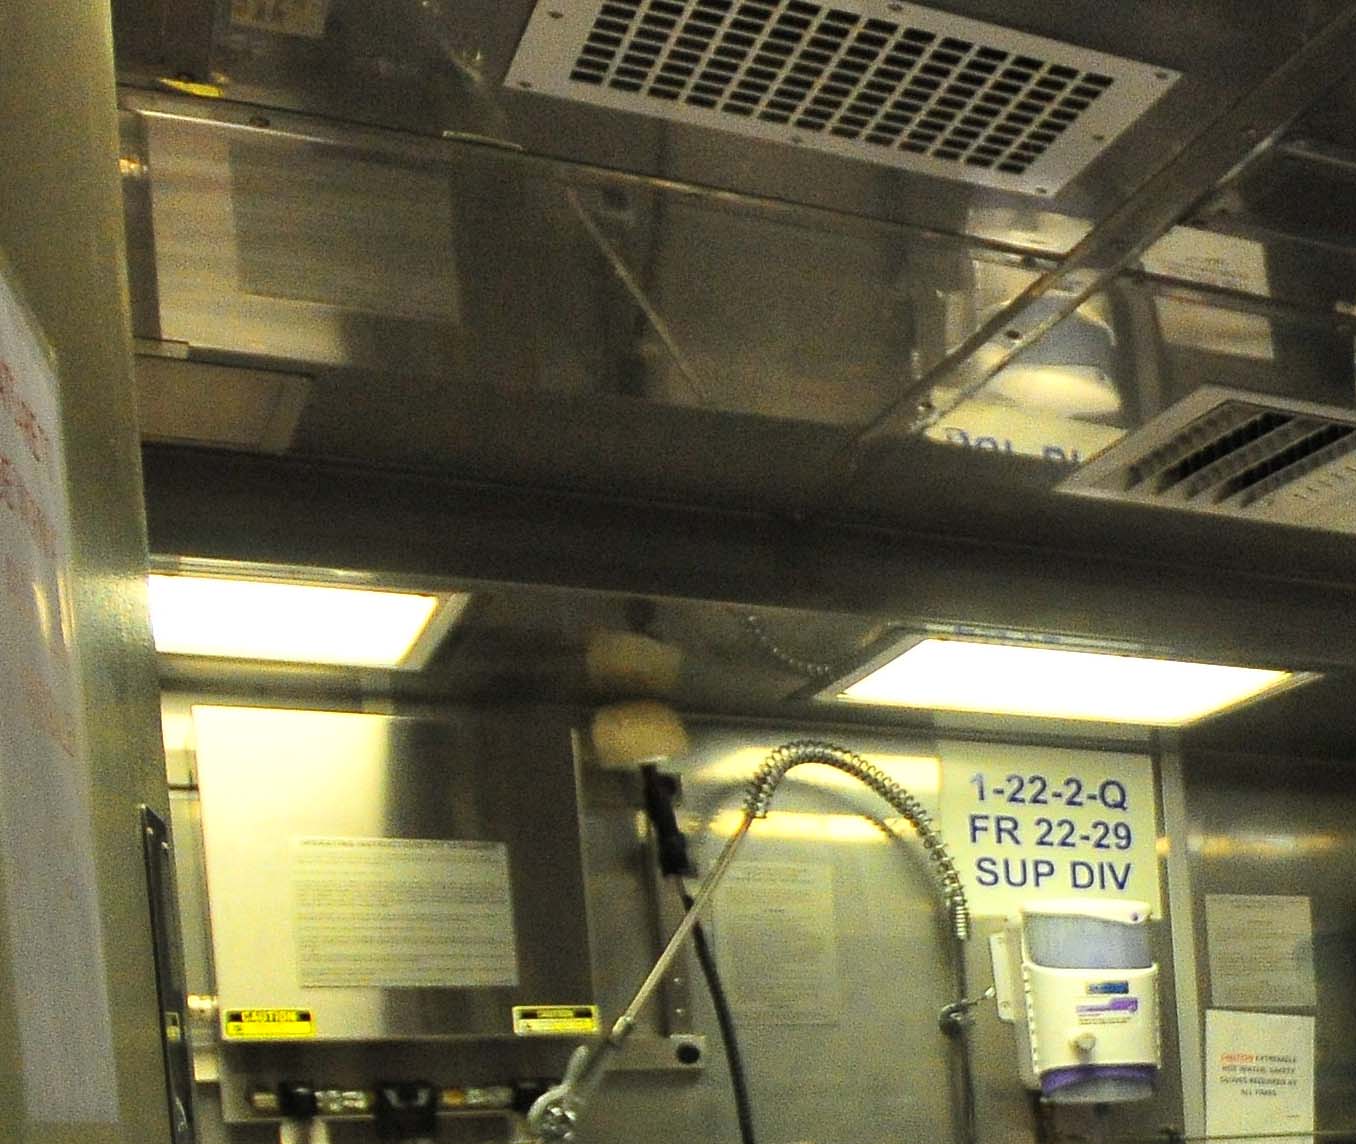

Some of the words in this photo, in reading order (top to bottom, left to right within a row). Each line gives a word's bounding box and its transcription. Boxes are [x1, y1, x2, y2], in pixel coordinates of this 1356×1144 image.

[970, 772, 1129, 811] 1-22-2-Q
[969, 814, 1021, 845] FR
[1034, 818, 1132, 850] 22-29
[975, 857, 1055, 888] SUP
[1070, 861, 1131, 890] DIV
